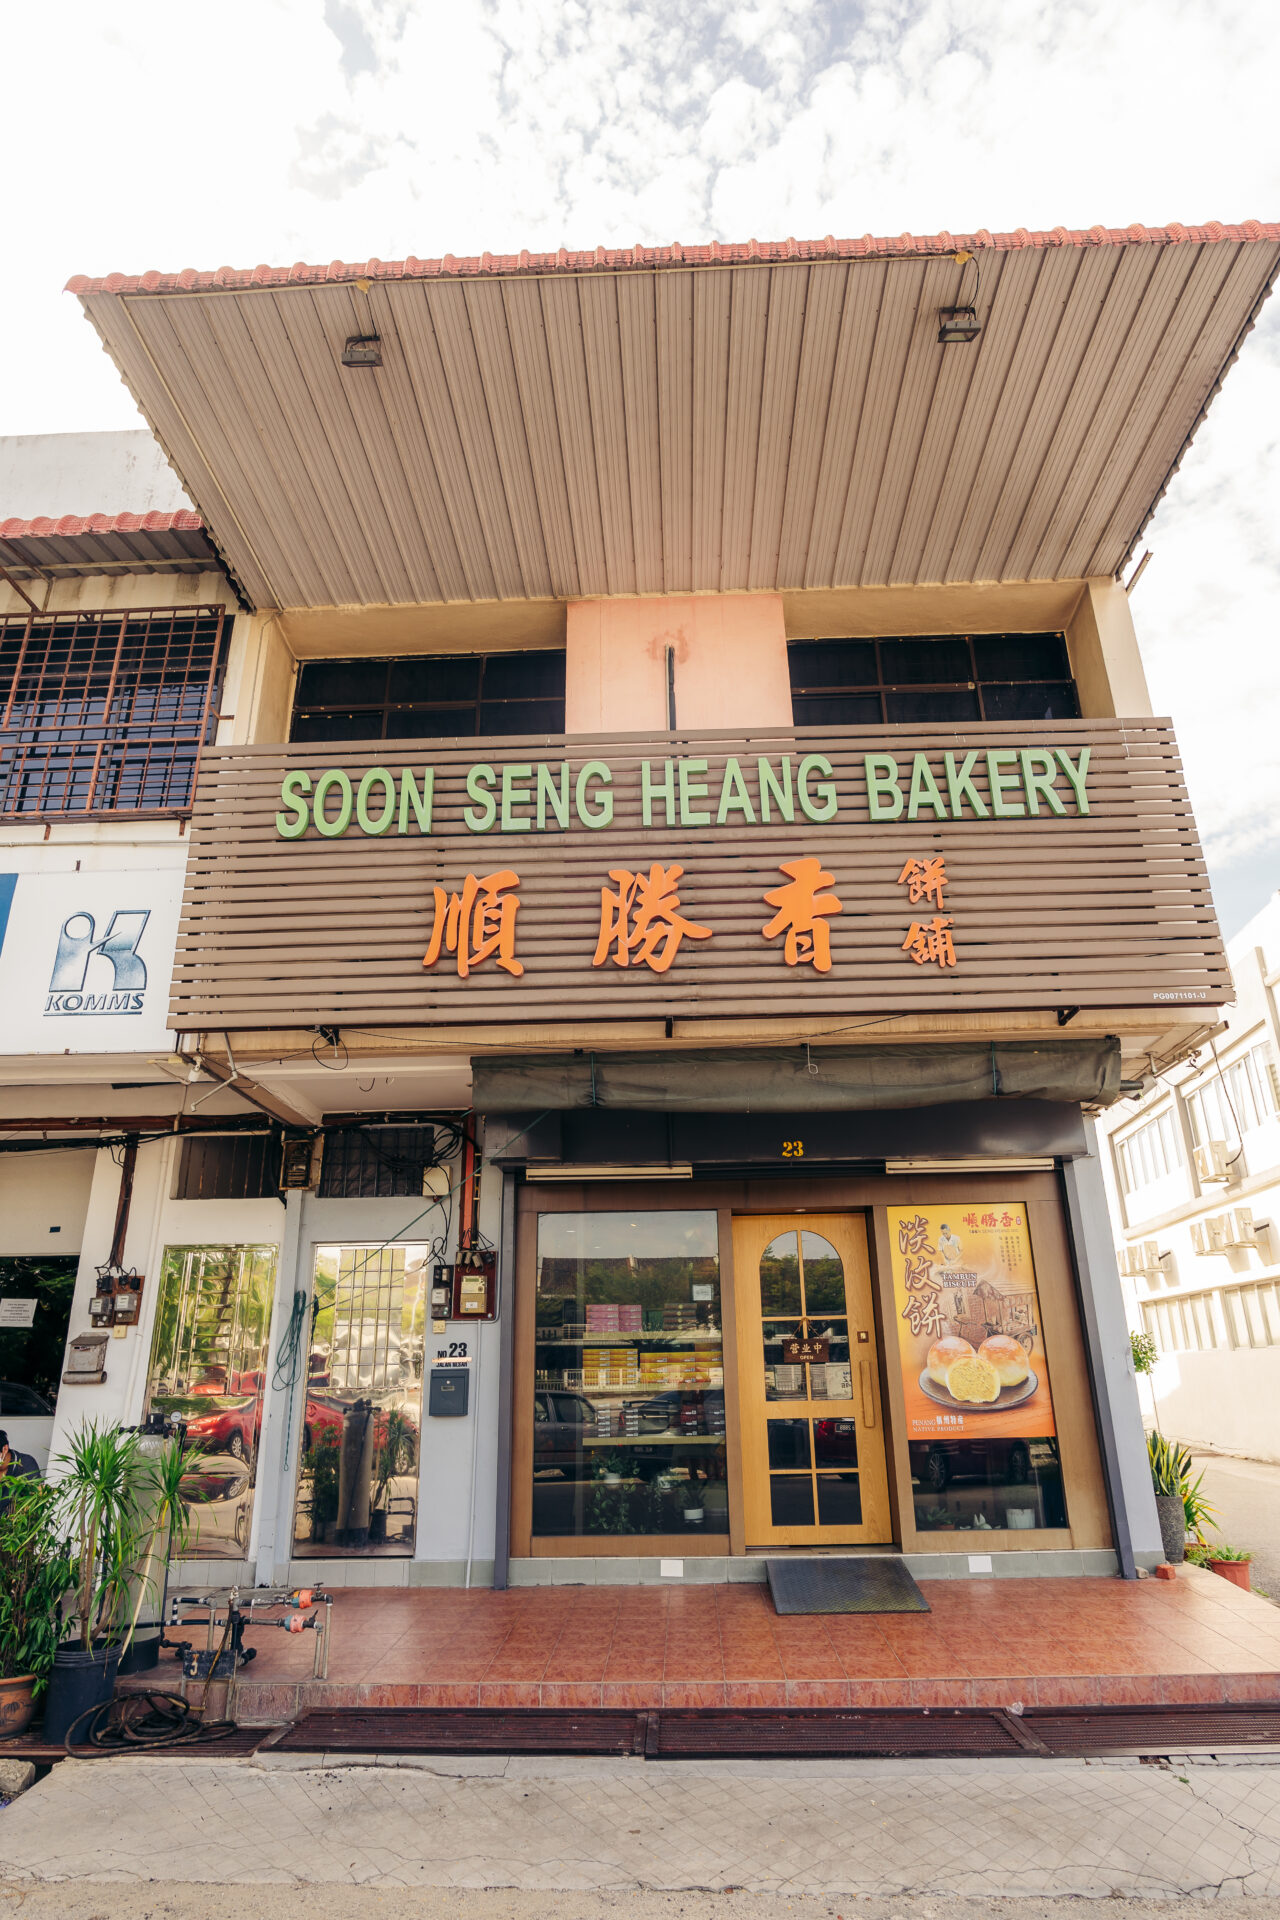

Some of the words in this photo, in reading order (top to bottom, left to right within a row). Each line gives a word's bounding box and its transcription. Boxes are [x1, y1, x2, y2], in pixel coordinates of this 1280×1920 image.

[275, 767, 434, 839] SOON
[463, 761, 614, 832] SENG
[641, 754, 838, 828] HEANG
[864, 747, 1092, 822] BAKERY
[44, 993, 145, 1011] KOMMS
[782, 1140, 804, 1157] 23
[449, 1342, 467, 1357] 23
